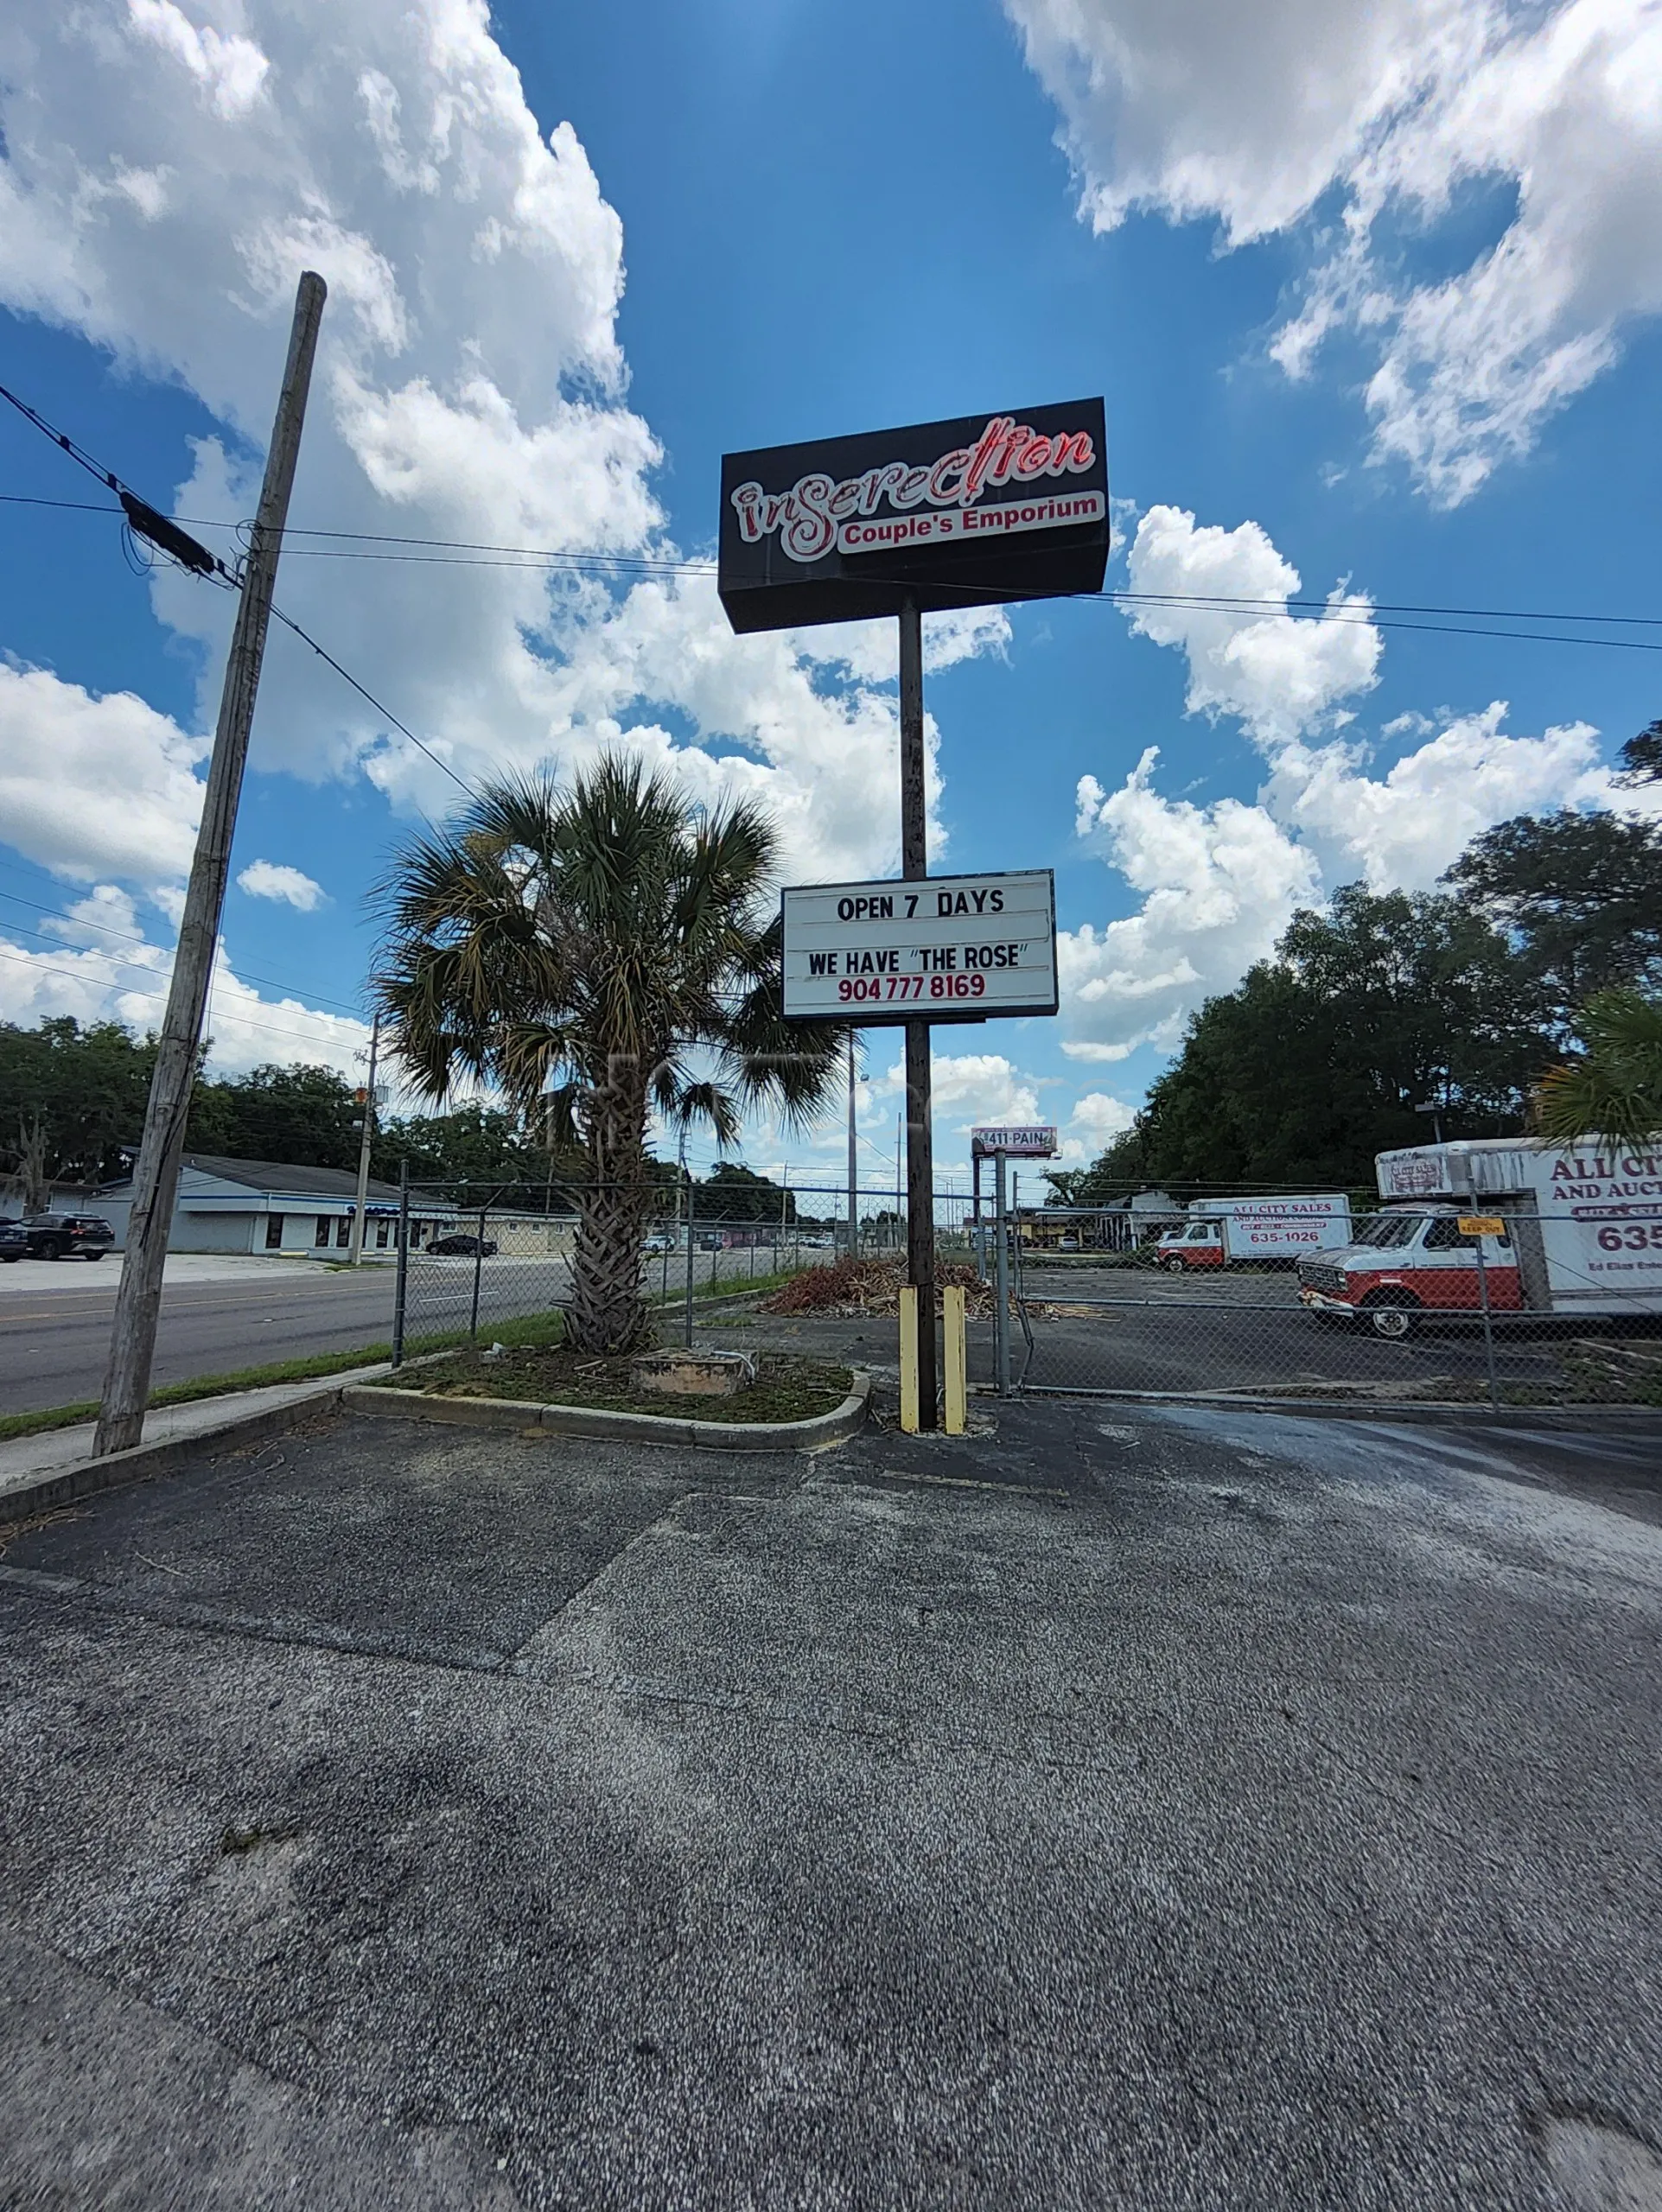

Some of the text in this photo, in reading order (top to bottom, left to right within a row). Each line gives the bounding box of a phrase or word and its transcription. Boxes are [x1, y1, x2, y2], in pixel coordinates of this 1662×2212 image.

[844, 497, 1097, 544] Couple's Emporium
[837, 889, 1004, 921] OPEN 7 DAYS
[809, 952, 837, 975] WE
[846, 950, 900, 974] HAVE
[838, 974, 985, 1001] 904 777 8169
[1550, 1157, 1614, 1181] ALL
[1552, 1184, 1602, 1200] AND
[1259, 1205, 1288, 1213] CITY
[1291, 1203, 1332, 1213] SALES
[1251, 1231, 1319, 1243] 635-1026
